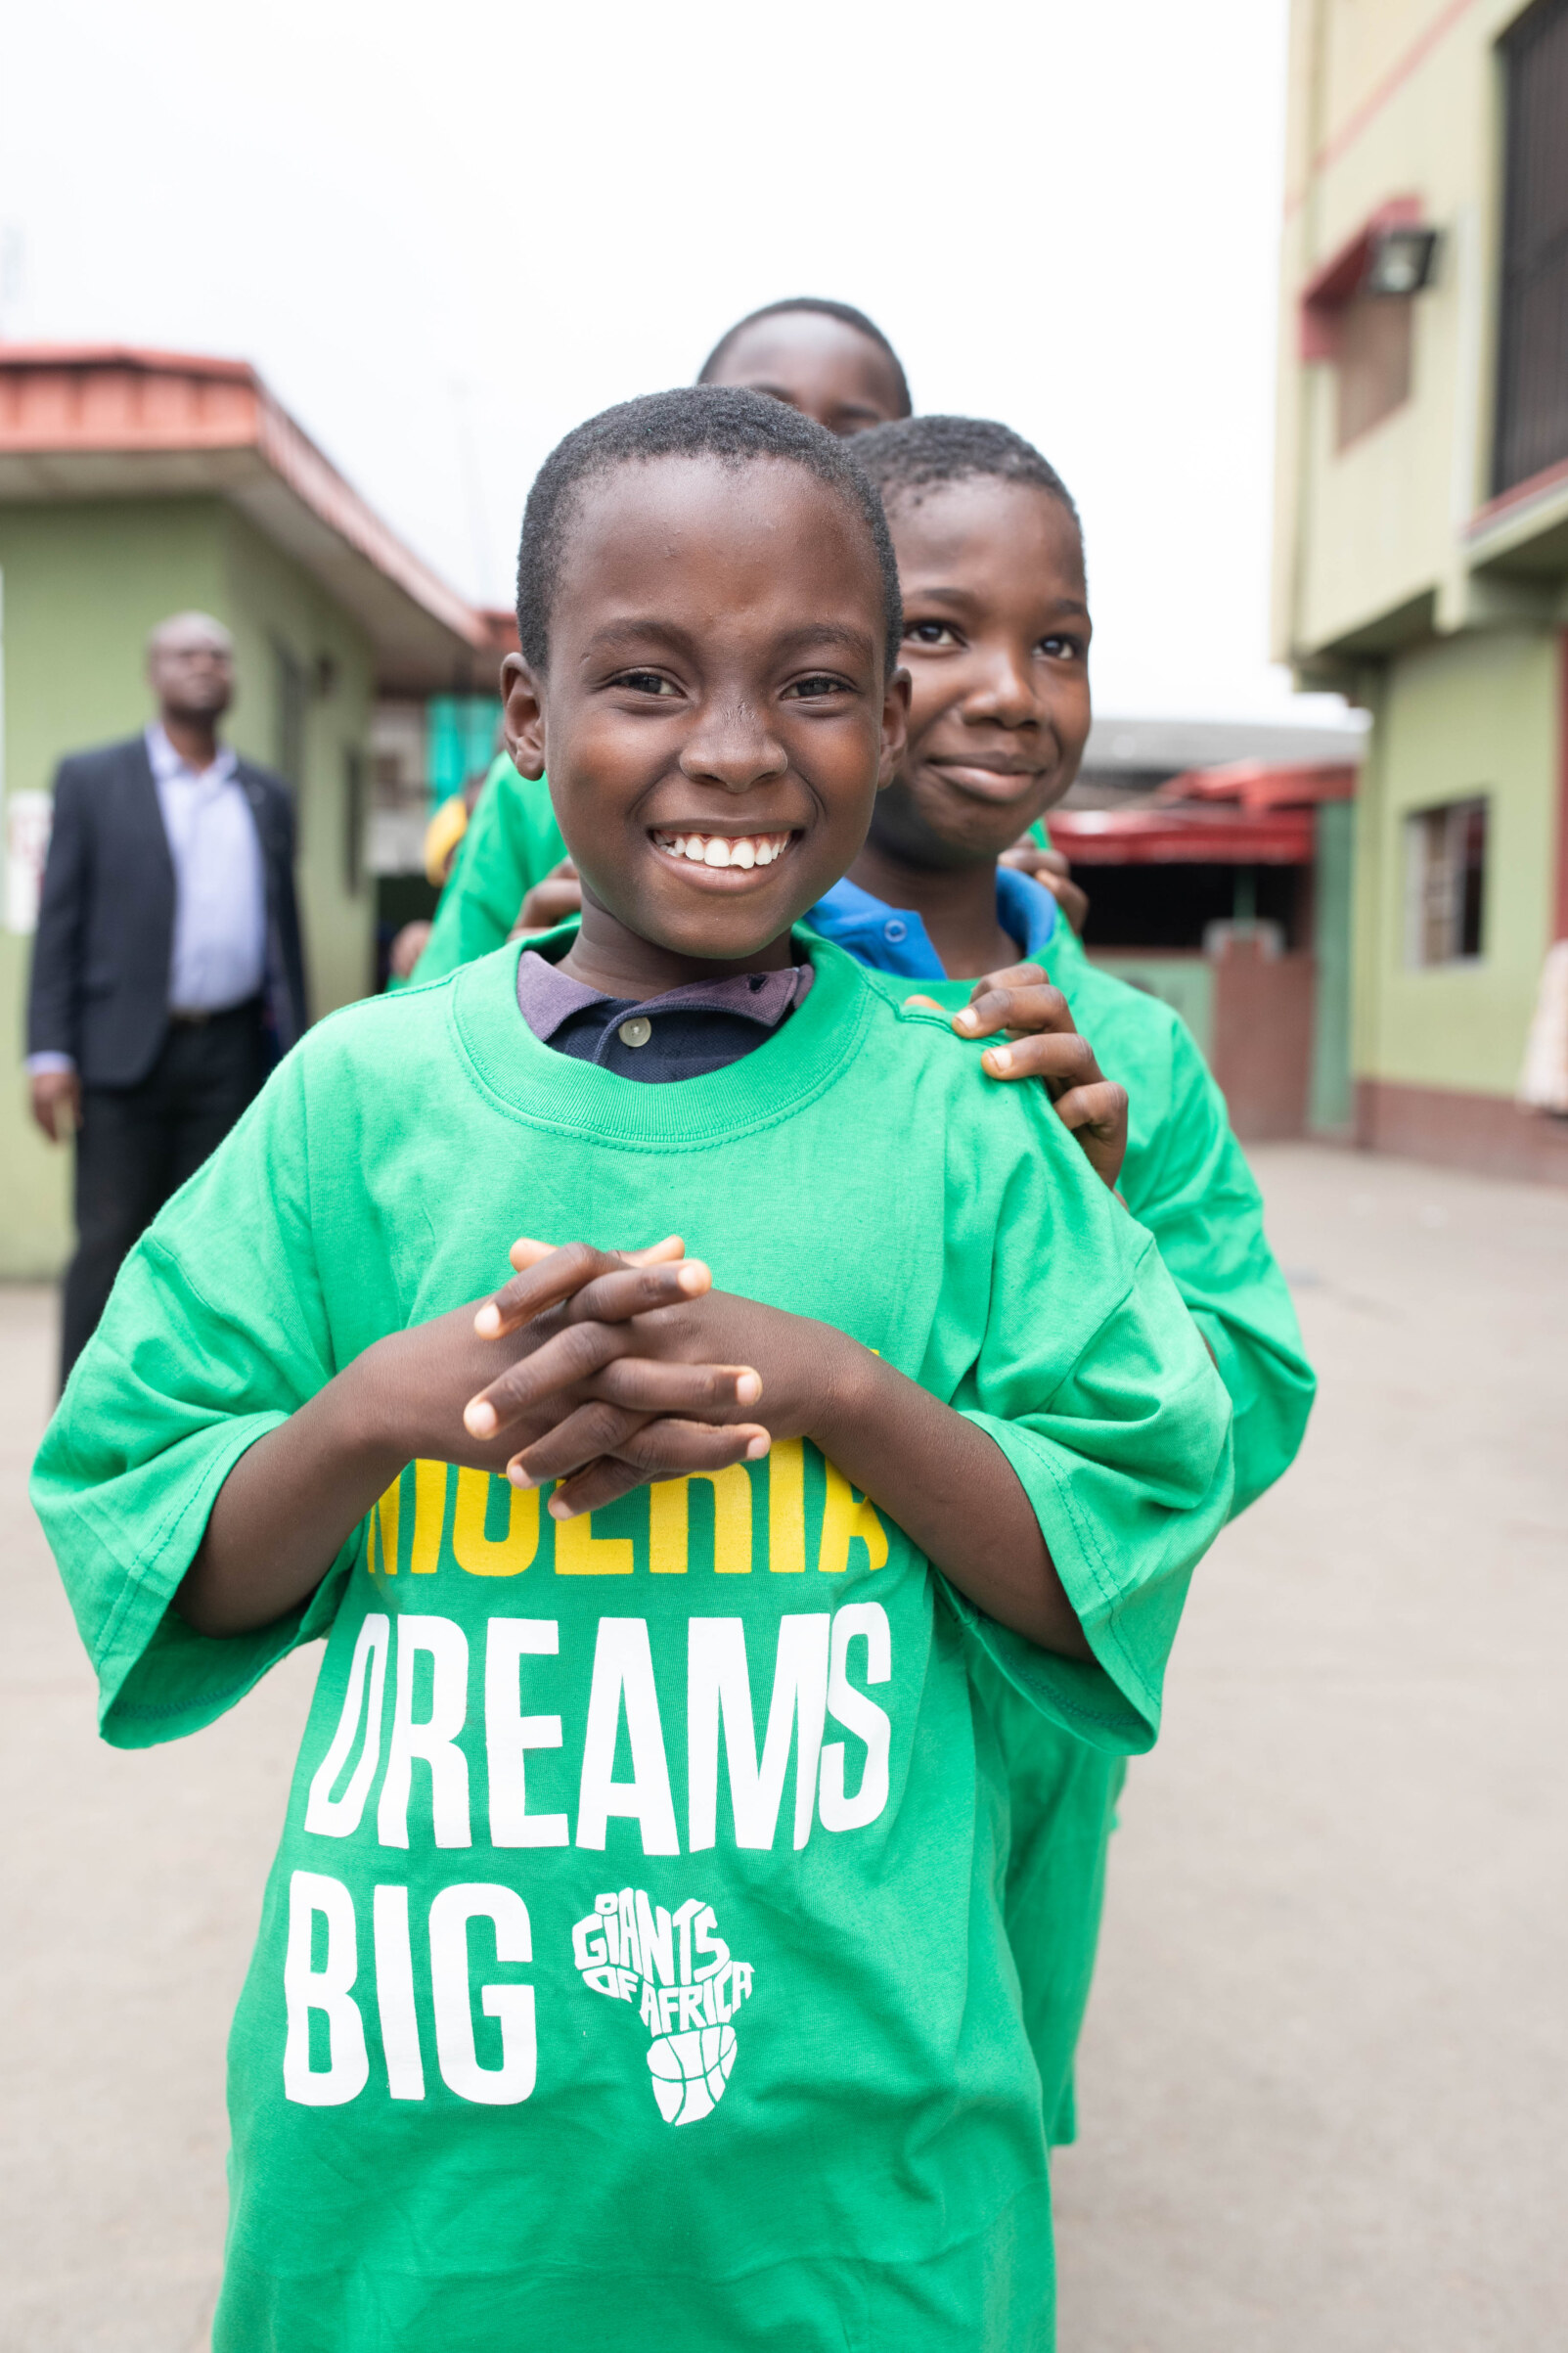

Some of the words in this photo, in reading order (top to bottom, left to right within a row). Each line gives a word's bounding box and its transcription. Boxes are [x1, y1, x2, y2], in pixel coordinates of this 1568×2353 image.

[303, 1602, 892, 1856] DREAMS
[283, 1870, 537, 2106] BIG
[582, 1966, 640, 2004] OF
[639, 1960, 755, 2038] AFRICA
